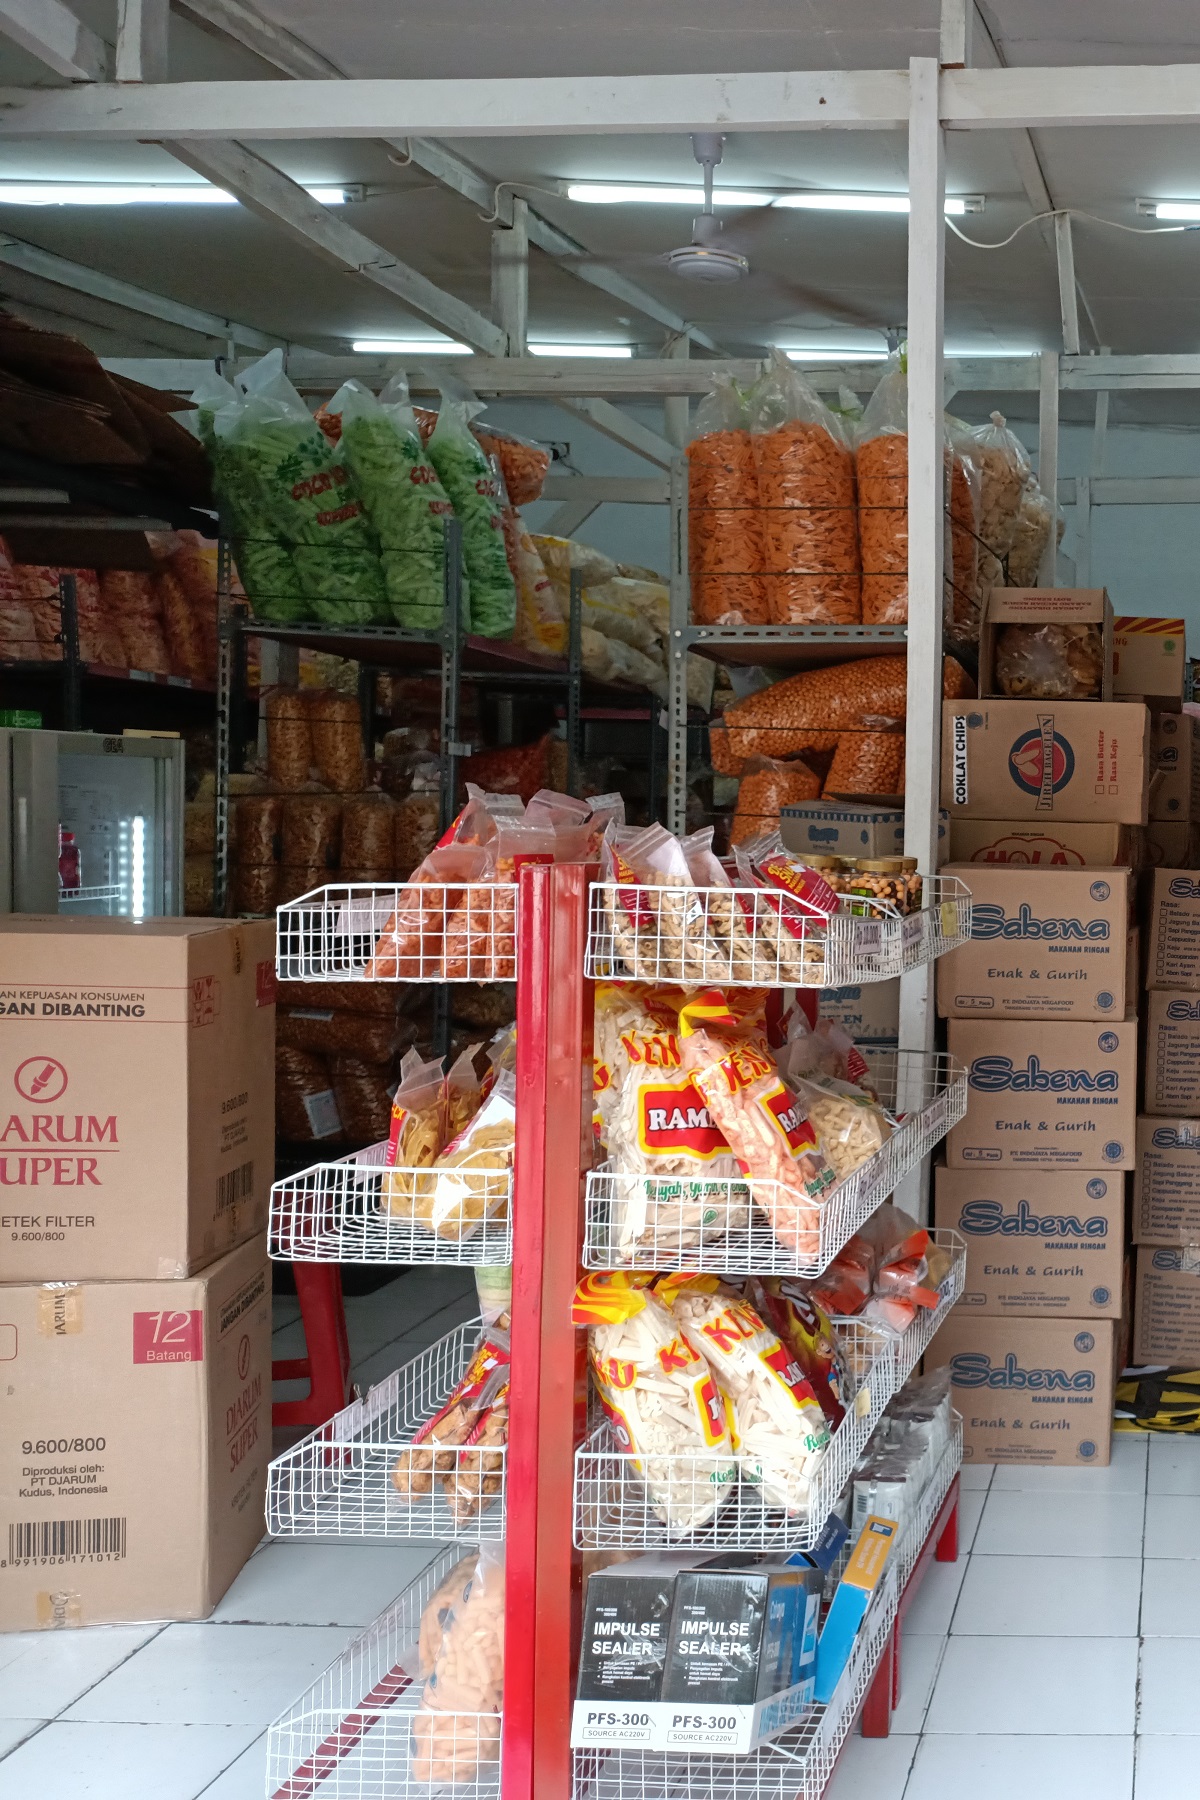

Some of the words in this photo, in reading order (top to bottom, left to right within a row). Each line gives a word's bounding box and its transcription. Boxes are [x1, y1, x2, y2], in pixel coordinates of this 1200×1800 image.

[1042, 718, 1053, 768] BAGELEN
[1096, 730, 1104, 759] Butter
[1096, 760, 1104, 782] Rasa
[1109, 761, 1117, 782] Rasa
[955, 755, 966, 804] COKLAT
[1039, 772, 1052, 808] JIREH
[968, 903, 1110, 940] Sabena
[1048, 945, 1081, 953] MAKANAN
[987, 968, 1023, 979] Enak
[1029, 968, 1040, 979] &
[1046, 968, 1088, 980] Gurih
[20, 991, 77, 1001] KEPUASAN
[80, 991, 145, 1001] KONSUMEN
[42, 1003, 146, 1018] DIBANTING
[968, 1054, 1119, 1092] Sabena
[1057, 1097, 1091, 1105] MAKANAN
[0, 1114, 118, 1142] ARUM
[995, 1120, 1031, 1131] Enak
[1037, 1121, 1048, 1131] &
[1055, 1120, 1096, 1132] Gurih
[0, 1157, 103, 1186] UPER
[45, 1216, 96, 1228] FILTER
[958, 1200, 1108, 1238] Sabena
[11, 1231, 65, 1242] 9.600/800
[1044, 1242, 1078, 1250] MAKANAN
[983, 1264, 1020, 1276] Enak
[1025, 1265, 1036, 1276] &
[1043, 1265, 1084, 1277] Gurih
[147, 1311, 192, 1344] 12
[146, 1349, 192, 1364] Batang
[950, 1352, 1095, 1392] Sabena
[1031, 1396, 1066, 1404] MAKANAN
[970, 1417, 1005, 1429] Enak
[1012, 1419, 1024, 1429] &
[1029, 1418, 1071, 1431] Gurih
[21, 1437, 107, 1455] 9.600/800
[230, 1417, 259, 1473] SUPER
[22, 1465, 77, 1477] Diproduksi
[78, 1463, 105, 1475] oleh:
[30, 1476, 46, 1486] PT
[48, 1475, 97, 1486] DJARUM
[19, 1486, 55, 1498] Kudus,
[57, 1485, 108, 1496] Indonesia
[15, 1556, 66, 1567] 991906
[71, 1552, 122, 1564] 171012
[593, 1621, 661, 1637] IMPULSE
[680, 1620, 750, 1637] IMPULSE
[591, 1641, 653, 1655] SEALER
[678, 1640, 742, 1656] SEALER
[587, 1712, 650, 1726] PFS-300
[672, 1715, 736, 1729] PFS-300
[619, 1730, 645, 1738] AC220V
[672, 1733, 703, 1741] SOURCE
[704, 1733, 732, 1742] AC220V
